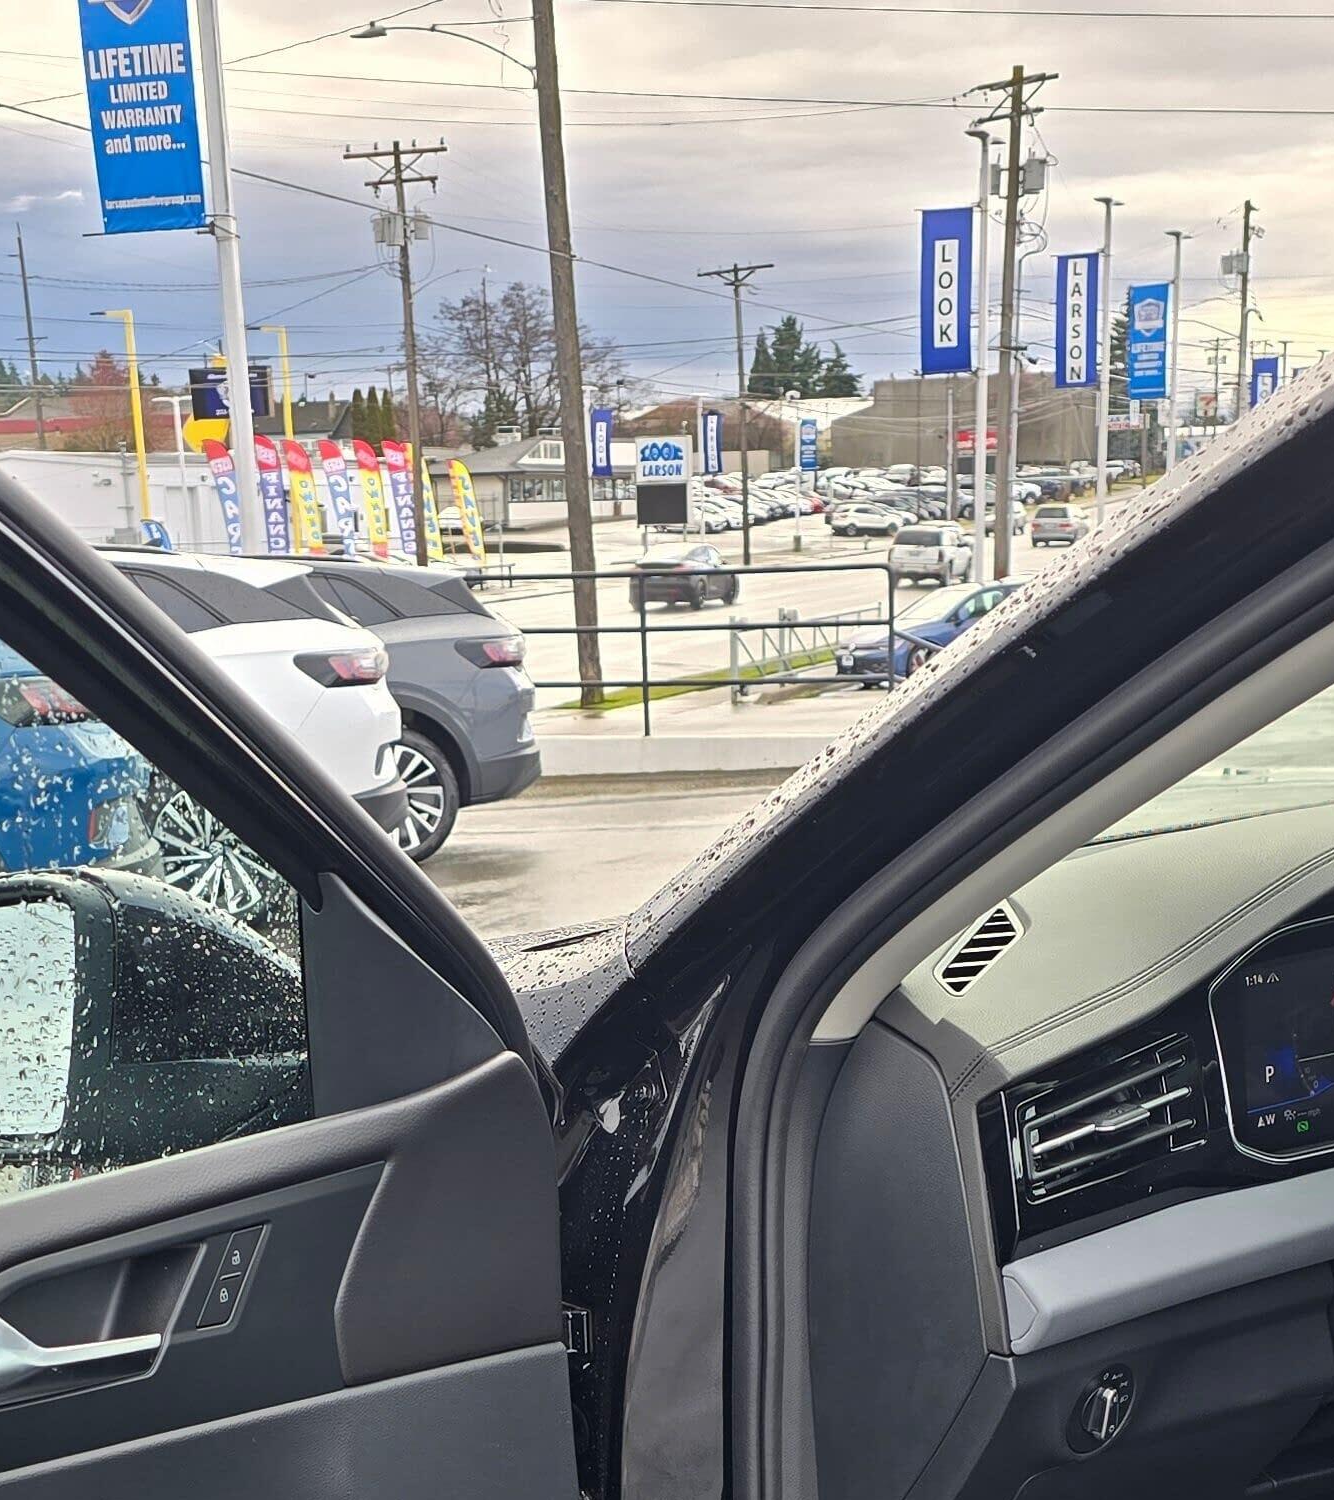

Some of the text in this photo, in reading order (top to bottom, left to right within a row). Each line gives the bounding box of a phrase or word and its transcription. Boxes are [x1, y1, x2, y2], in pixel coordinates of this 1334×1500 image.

[88, 43, 187, 80] LIFETIME
[109, 81, 168, 104] LIMITED
[101, 104, 182, 130] WARRANTY
[105, 134, 186, 154] and more...
[939, 244, 953, 343] LOOK
[1069, 262, 1083, 381] LARSON
[640, 442, 684, 461] LOOK
[642, 464, 682, 477] LARSON
[1245, 974, 1263, 987] 1:14
[1265, 1065, 1275, 1083] P
